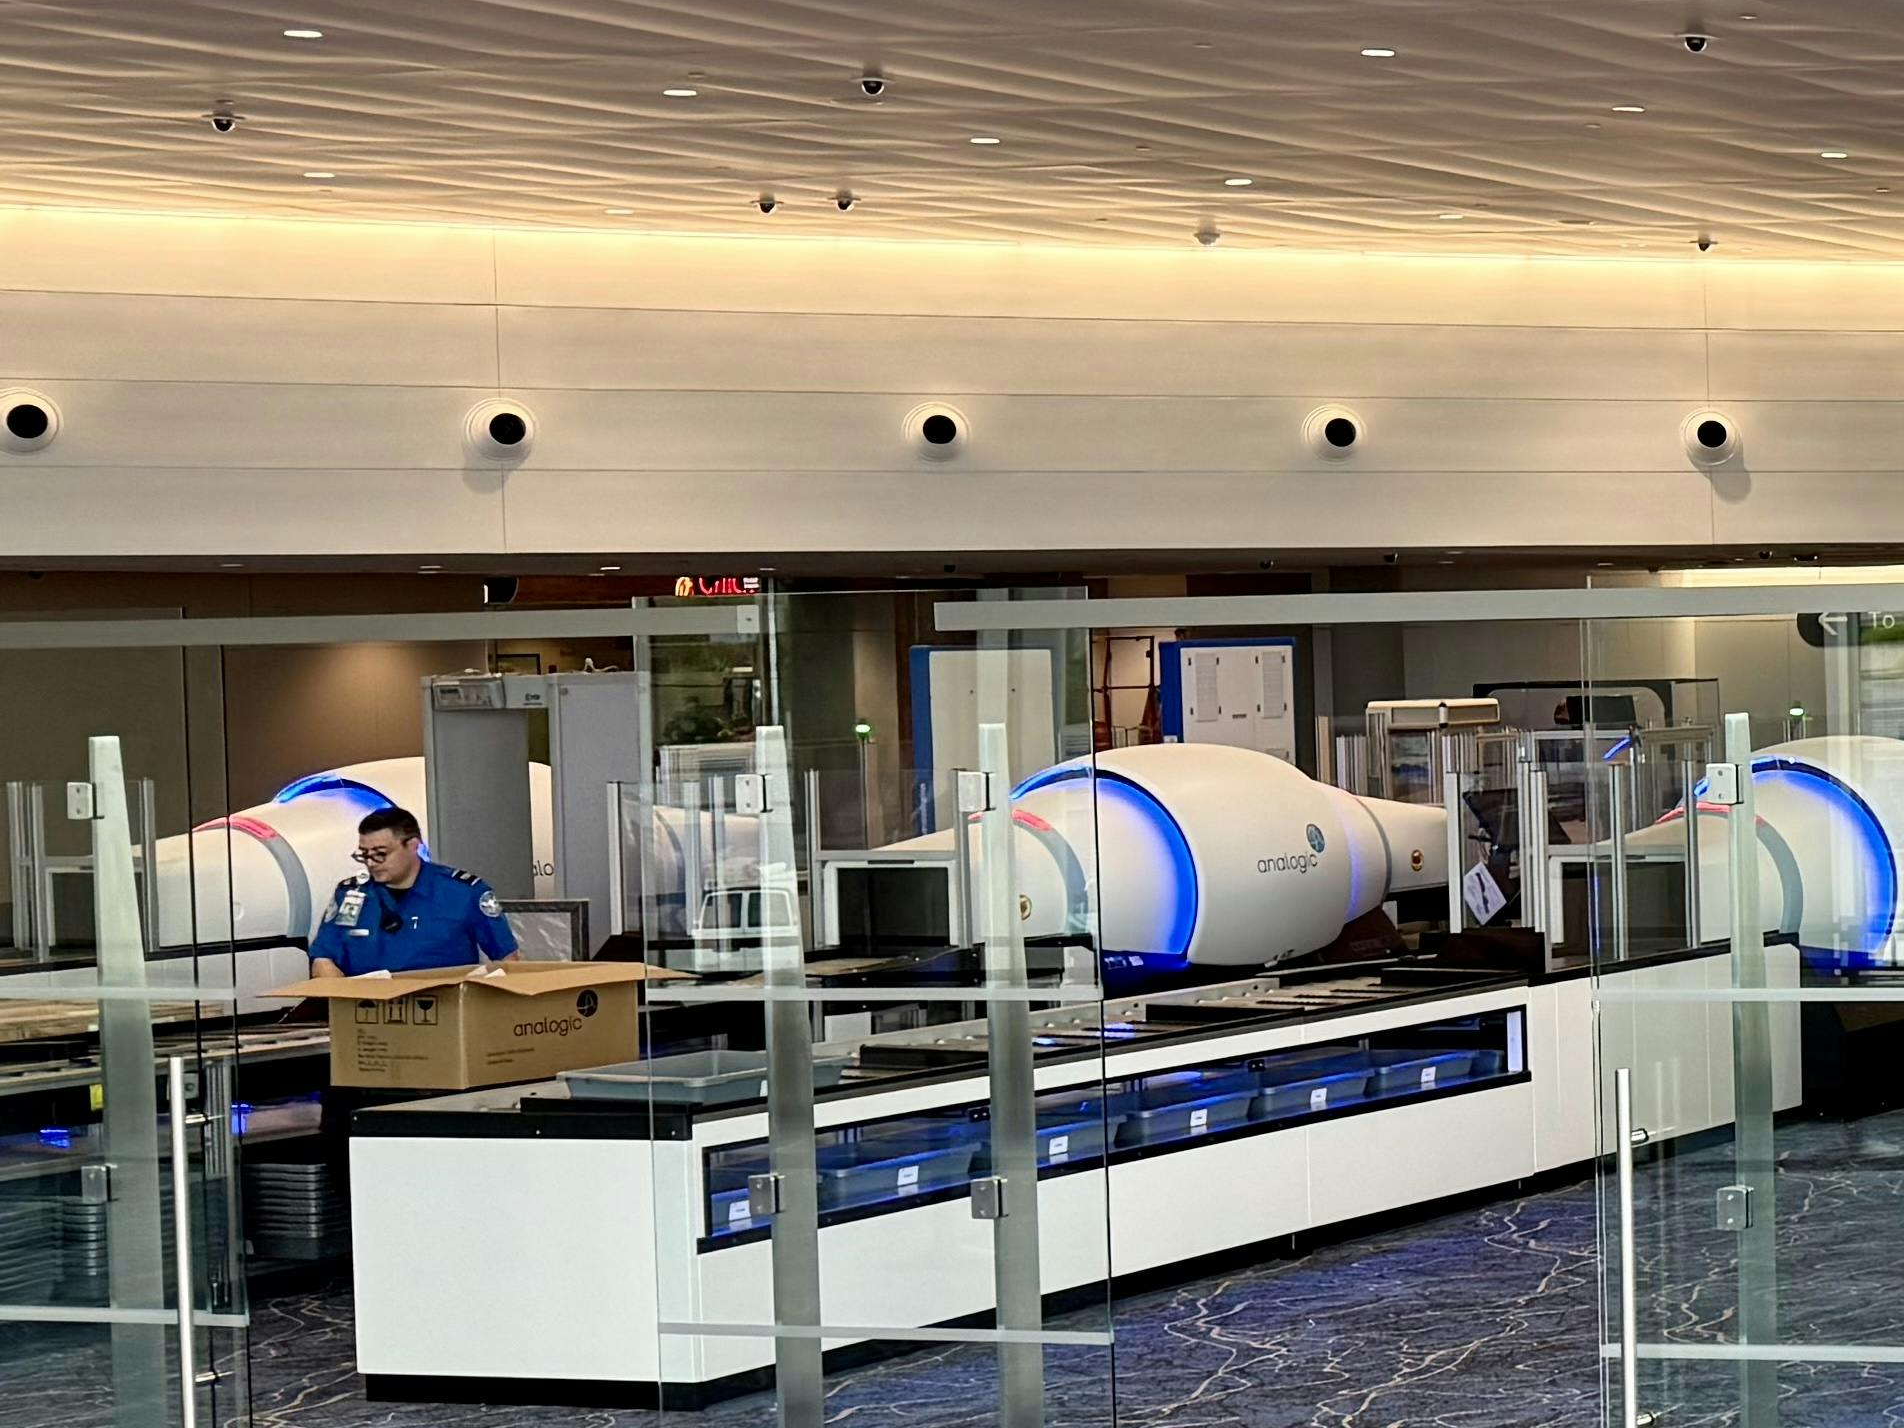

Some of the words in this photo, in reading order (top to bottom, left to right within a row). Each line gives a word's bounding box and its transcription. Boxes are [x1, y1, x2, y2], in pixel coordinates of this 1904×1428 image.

[1868, 610, 1895, 629] To
[1257, 851, 1318, 874] analogic
[513, 1015, 583, 1037] analogic
